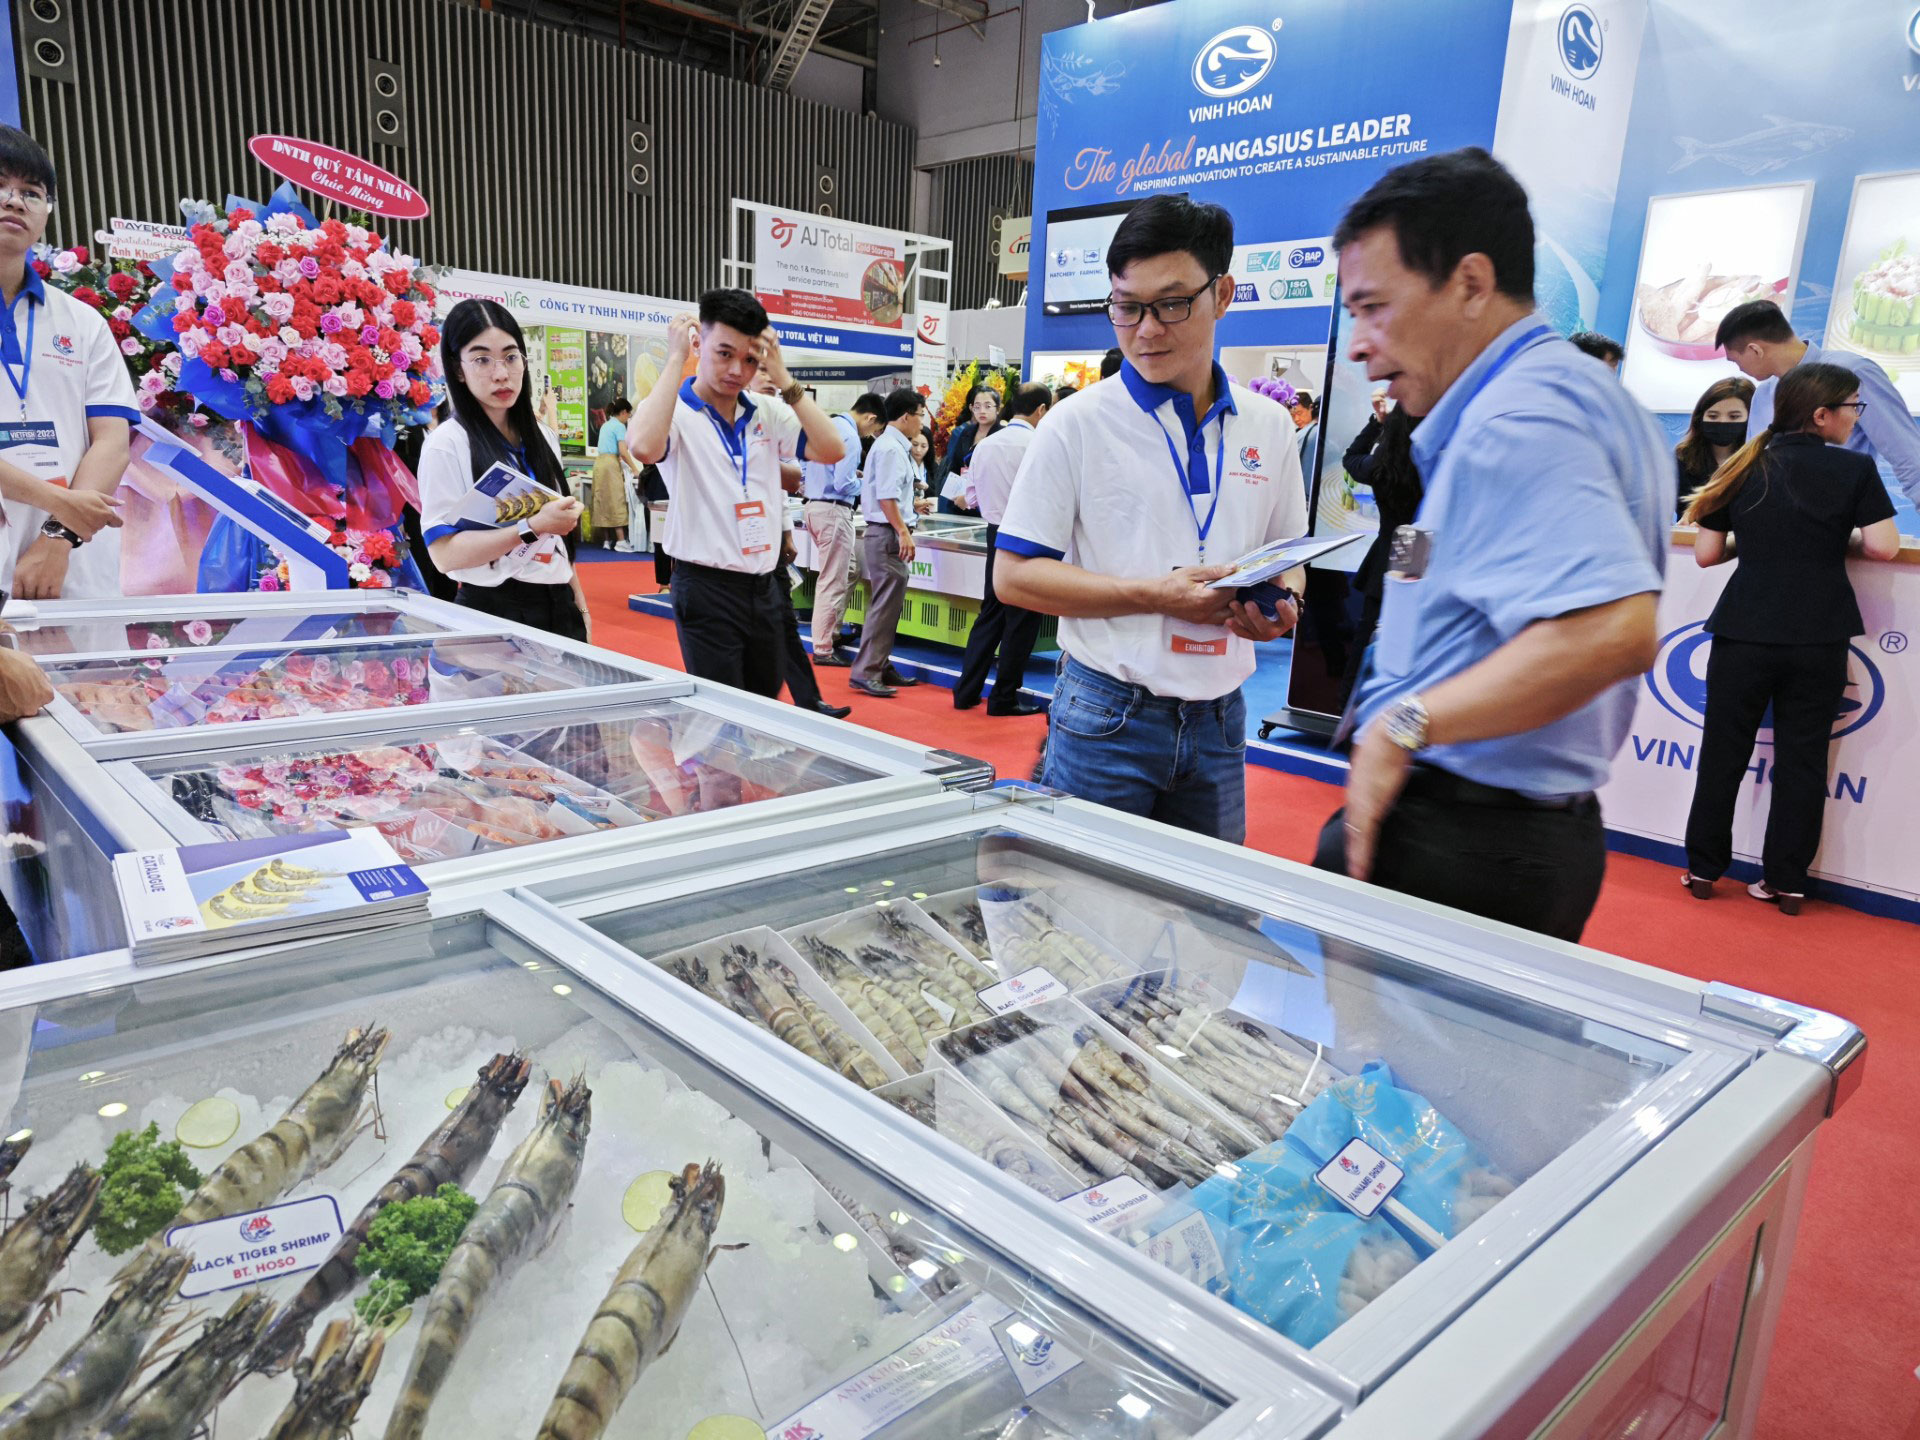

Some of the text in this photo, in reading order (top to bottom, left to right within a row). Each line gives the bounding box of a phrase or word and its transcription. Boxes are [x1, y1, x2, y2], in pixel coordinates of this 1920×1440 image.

[1551, 73, 1597, 111] VINH HOAN
[1189, 93, 1273, 124] VINH HOAN
[1064, 113, 1412, 195] The global PANGASIUS LEADER
[1133, 139, 1428, 192] INSPIRING INNOVATION TO CREATE A SUSTAINABLE FUTURE
[272, 139, 413, 202] DNTH QUÝ TÂM NHÂN
[311, 170, 385, 209] Chúc Mừng
[800, 226, 818, 246] AJ
[820, 229, 854, 252] Total
[1304, 251, 1322, 261] BAP
[776, 260, 788, 270] The
[805, 265, 809, 273] &
[810, 267, 827, 276] most
[827, 269, 849, 279] trusted
[1050, 271, 1075, 279] HATCHERY
[787, 275, 840, 289] service partners
[540, 297, 673, 325] CÔNG TY TNHH NHỊP SỐNG
[785, 330, 806, 341] TOTAL
[808, 332, 823, 345] VIỆT
[824, 335, 840, 345] NAM
[37, 429, 55, 438] 2023
[908, 561, 932, 577] IWI
[1185, 643, 1215, 653] EXHIBITOR
[142, 855, 165, 893] CATALOGUE
[1119, 1194, 1149, 1210] SHRIMP
[247, 1213, 272, 1232] AK
[187, 1232, 331, 1274] BLACK TIGER SHRIMP
[233, 1256, 296, 1279] BT. HOSO
